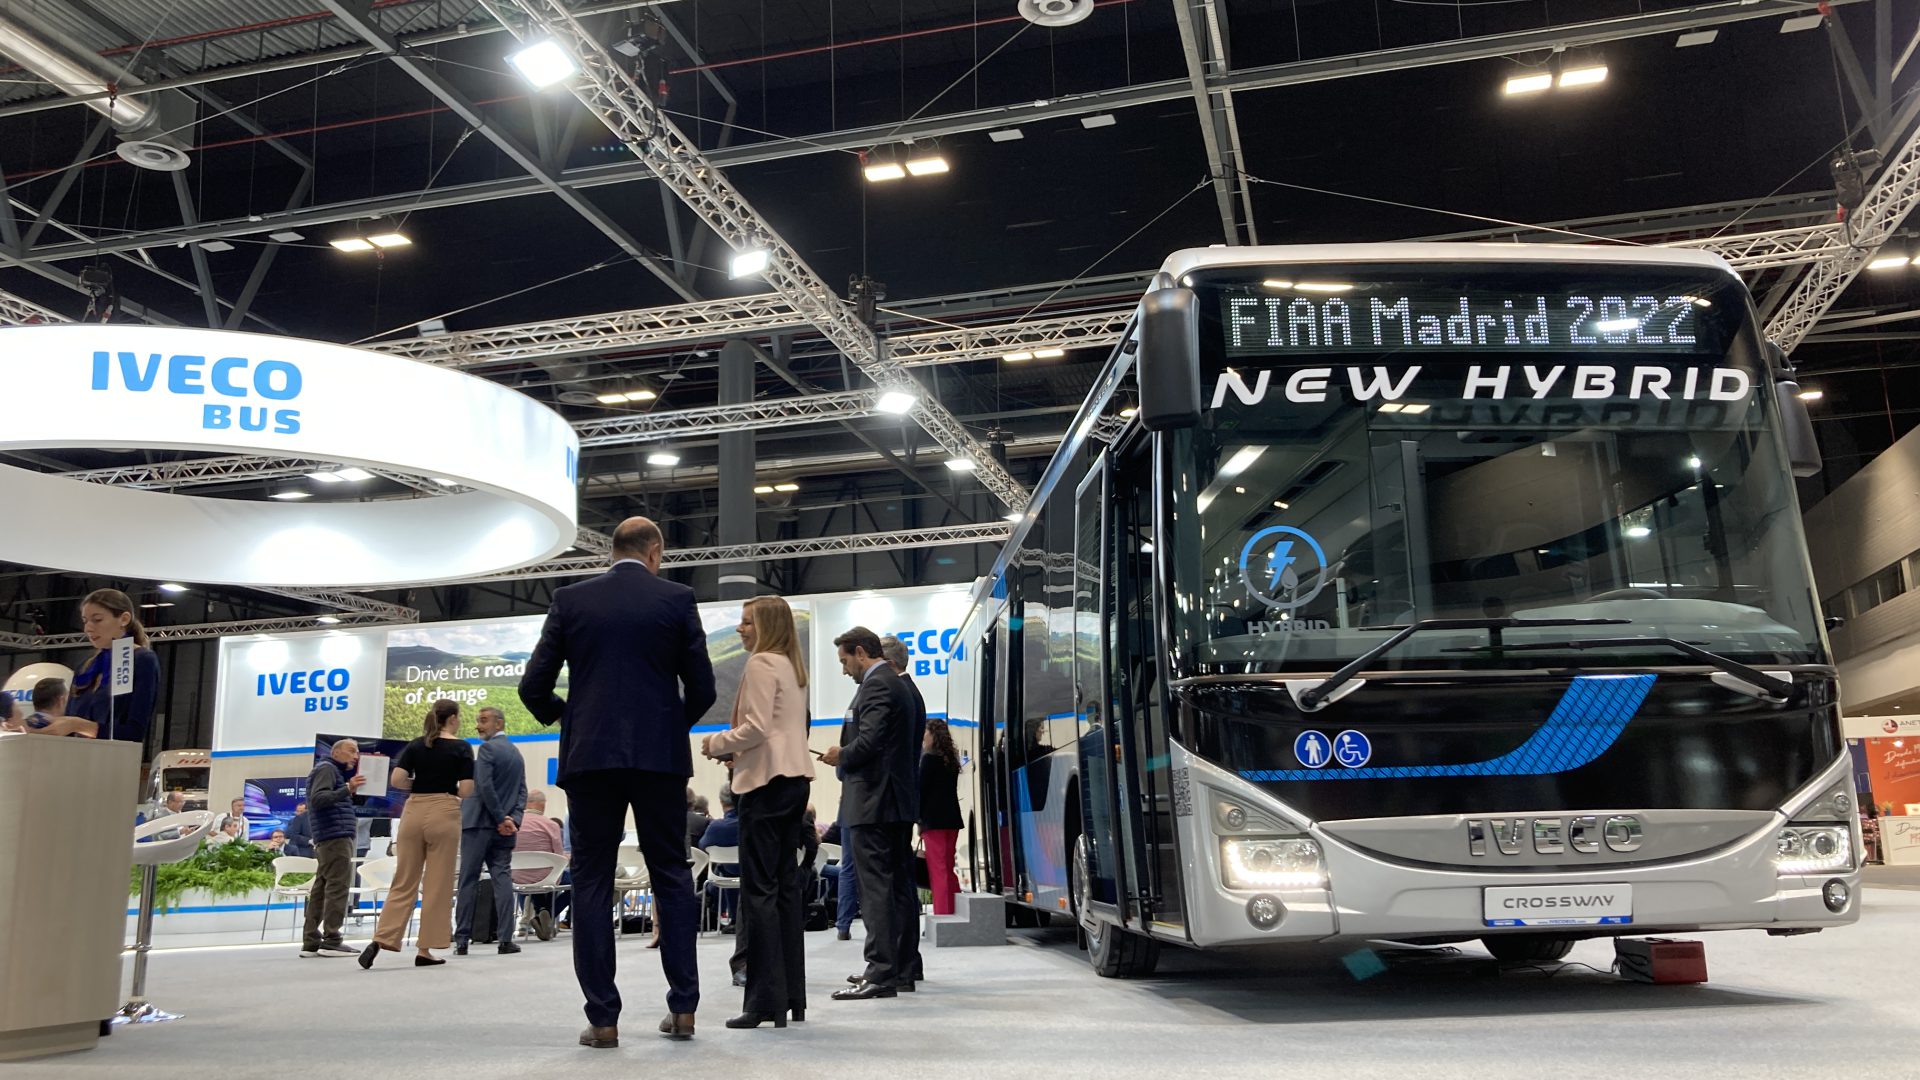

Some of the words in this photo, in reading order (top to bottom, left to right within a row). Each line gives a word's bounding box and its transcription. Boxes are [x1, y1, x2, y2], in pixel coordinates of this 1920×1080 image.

[1230, 297, 1351, 347] FIAA
[1371, 296, 1550, 346] Madrid
[1567, 296, 1697, 345] 2022
[92, 351, 303, 401] IVECO
[1210, 366, 1423, 408] NEW
[1462, 366, 1750, 401] HYBRID
[203, 404, 301, 435] BUS
[1247, 619, 1330, 636] HYBRID
[122, 646, 130, 685] IVECO
[406, 665, 449, 683] Drive
[453, 662, 480, 680] the
[484, 659, 526, 678] road
[915, 659, 950, 677] BU
[256, 668, 350, 696] IVECO
[304, 695, 349, 713] BUS
[405, 688, 423, 705] of
[427, 687, 488, 706] change
[1468, 815, 1644, 857] IVECO
[1503, 895, 1615, 909] CROSSWAY
